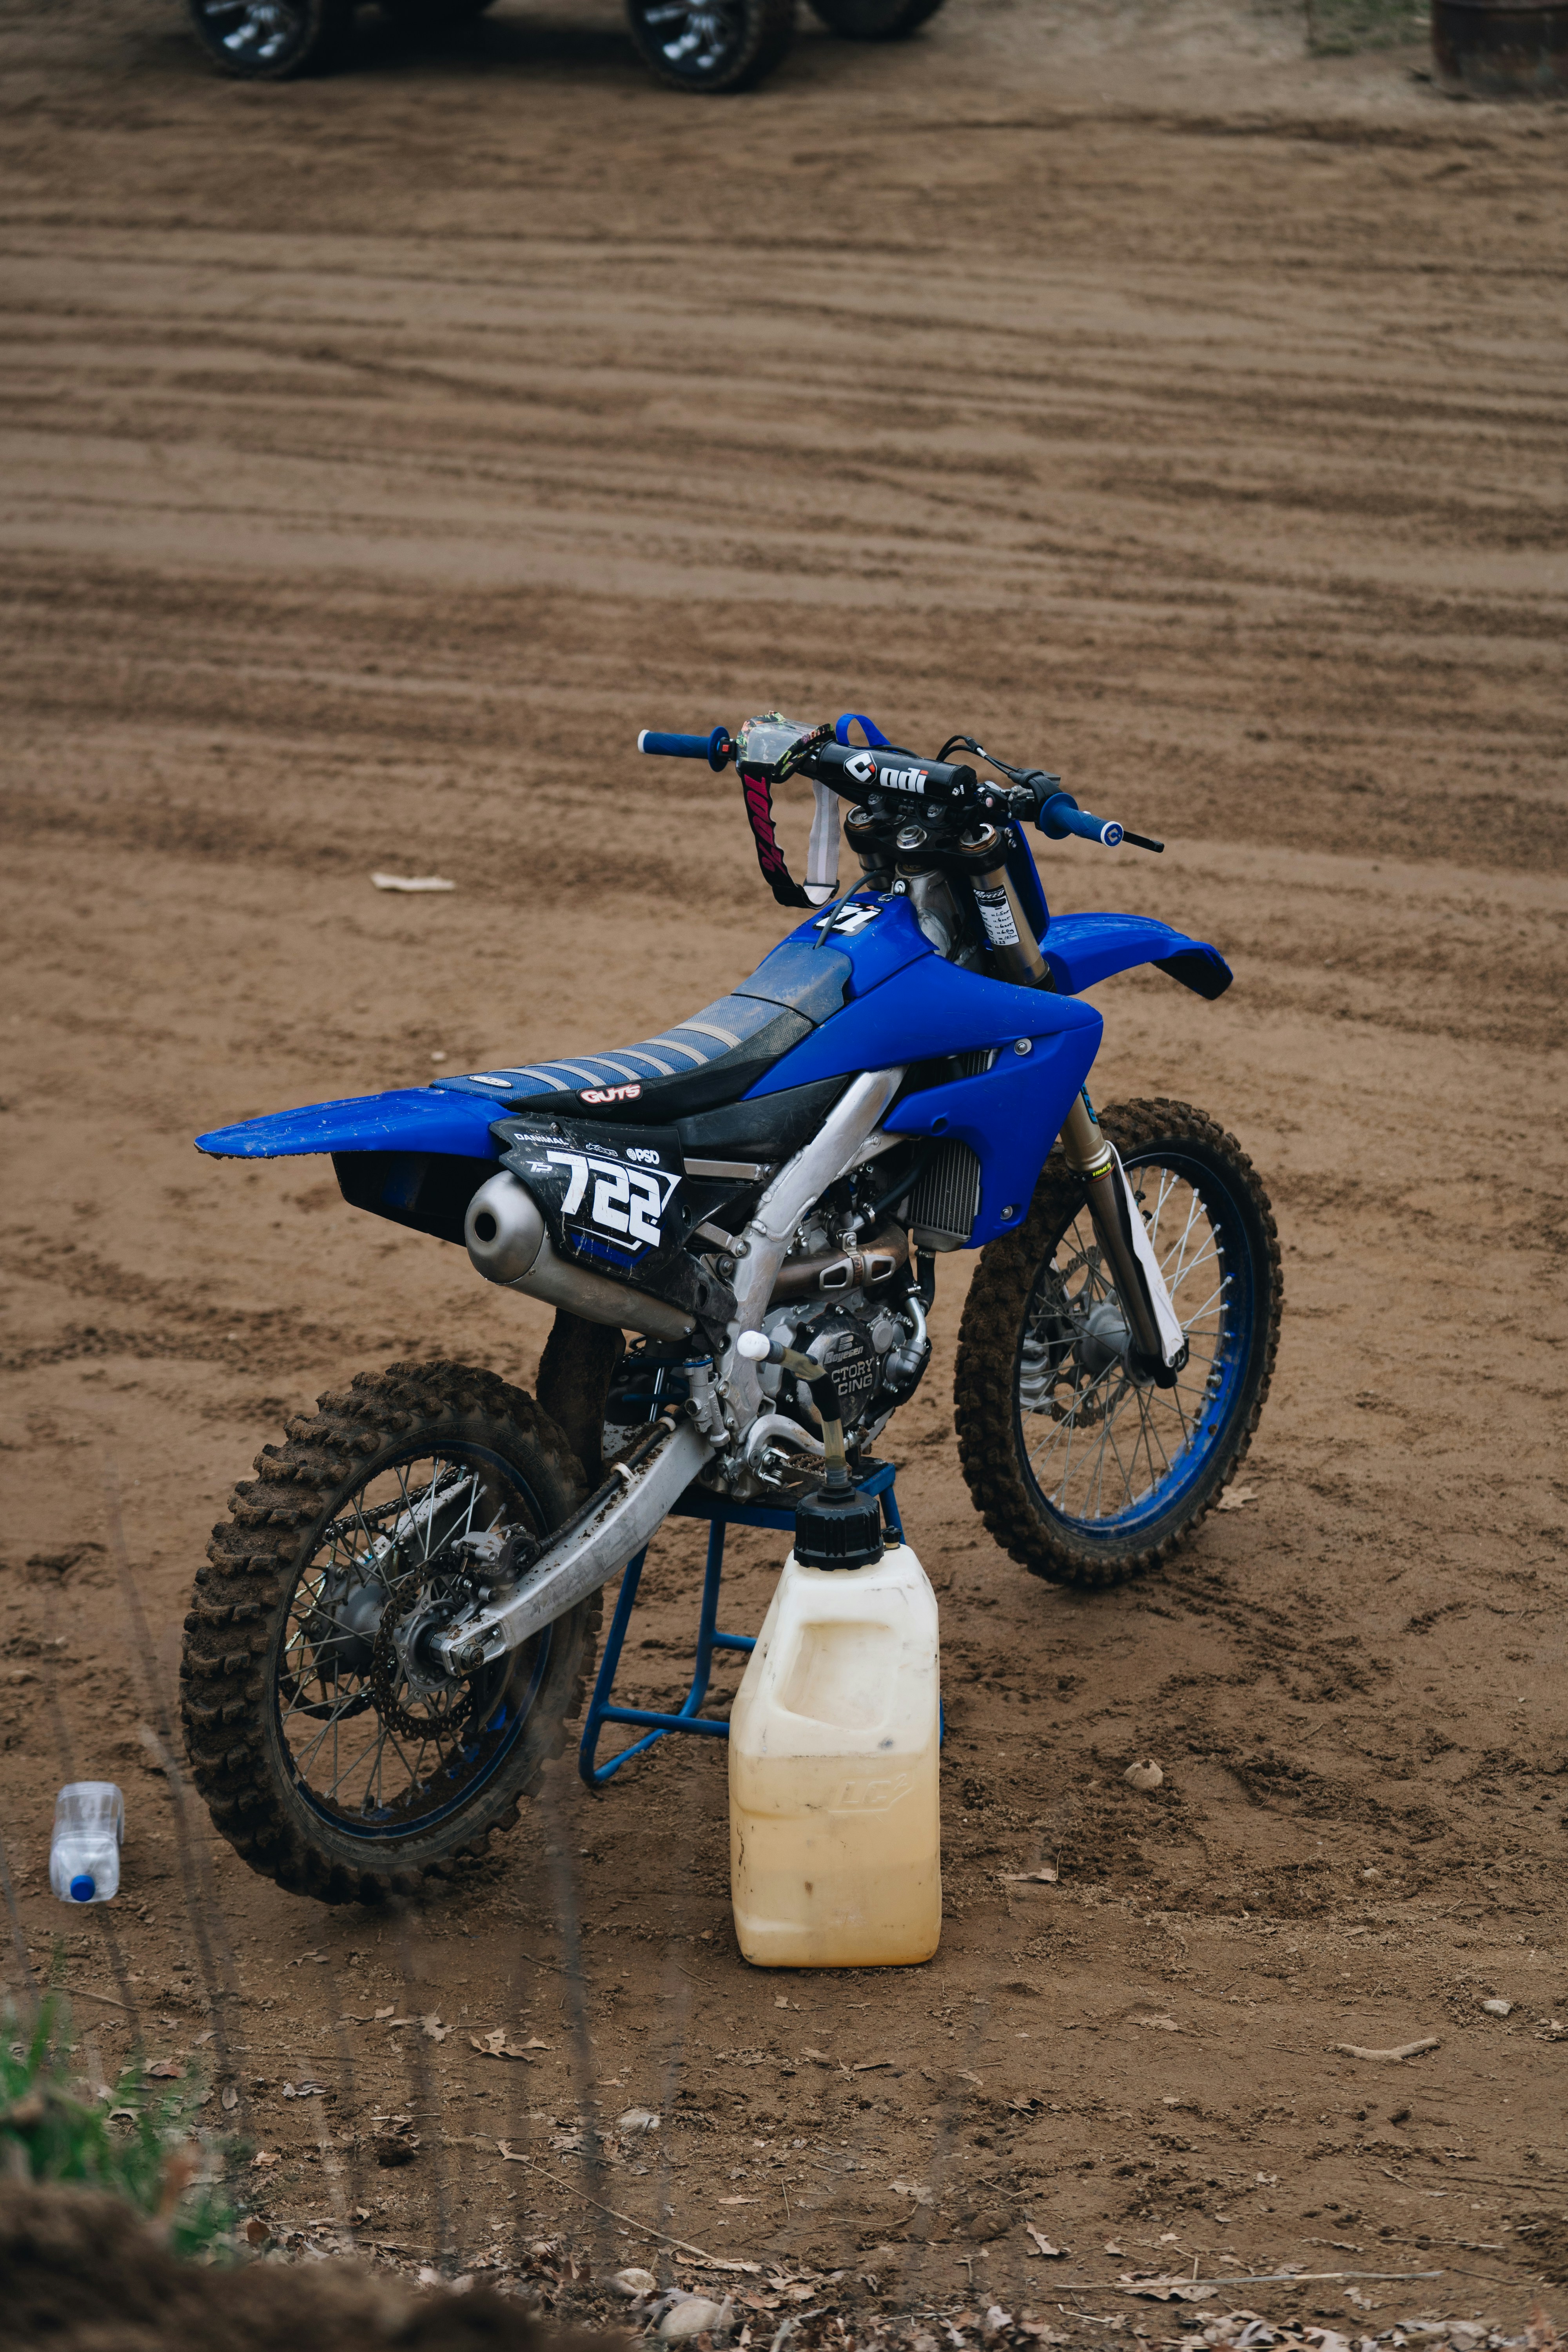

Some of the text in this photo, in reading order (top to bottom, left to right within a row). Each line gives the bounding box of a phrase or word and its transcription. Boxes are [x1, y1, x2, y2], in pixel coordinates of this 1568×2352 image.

[880, 768, 929, 794] odi
[744, 774, 788, 877] 100%
[977, 889, 1004, 898] SPEED
[581, 1084, 641, 1103] GUTS
[514, 1133, 569, 1145] DANIMAL
[635, 1148, 660, 1165] PSD
[525, 1161, 553, 1173] TP
[546, 1150, 661, 1247] 722
[824, 1346, 864, 1365] Boyesen
[831, 1358, 873, 1383] CTORY
[838, 1373, 873, 1396] CING
